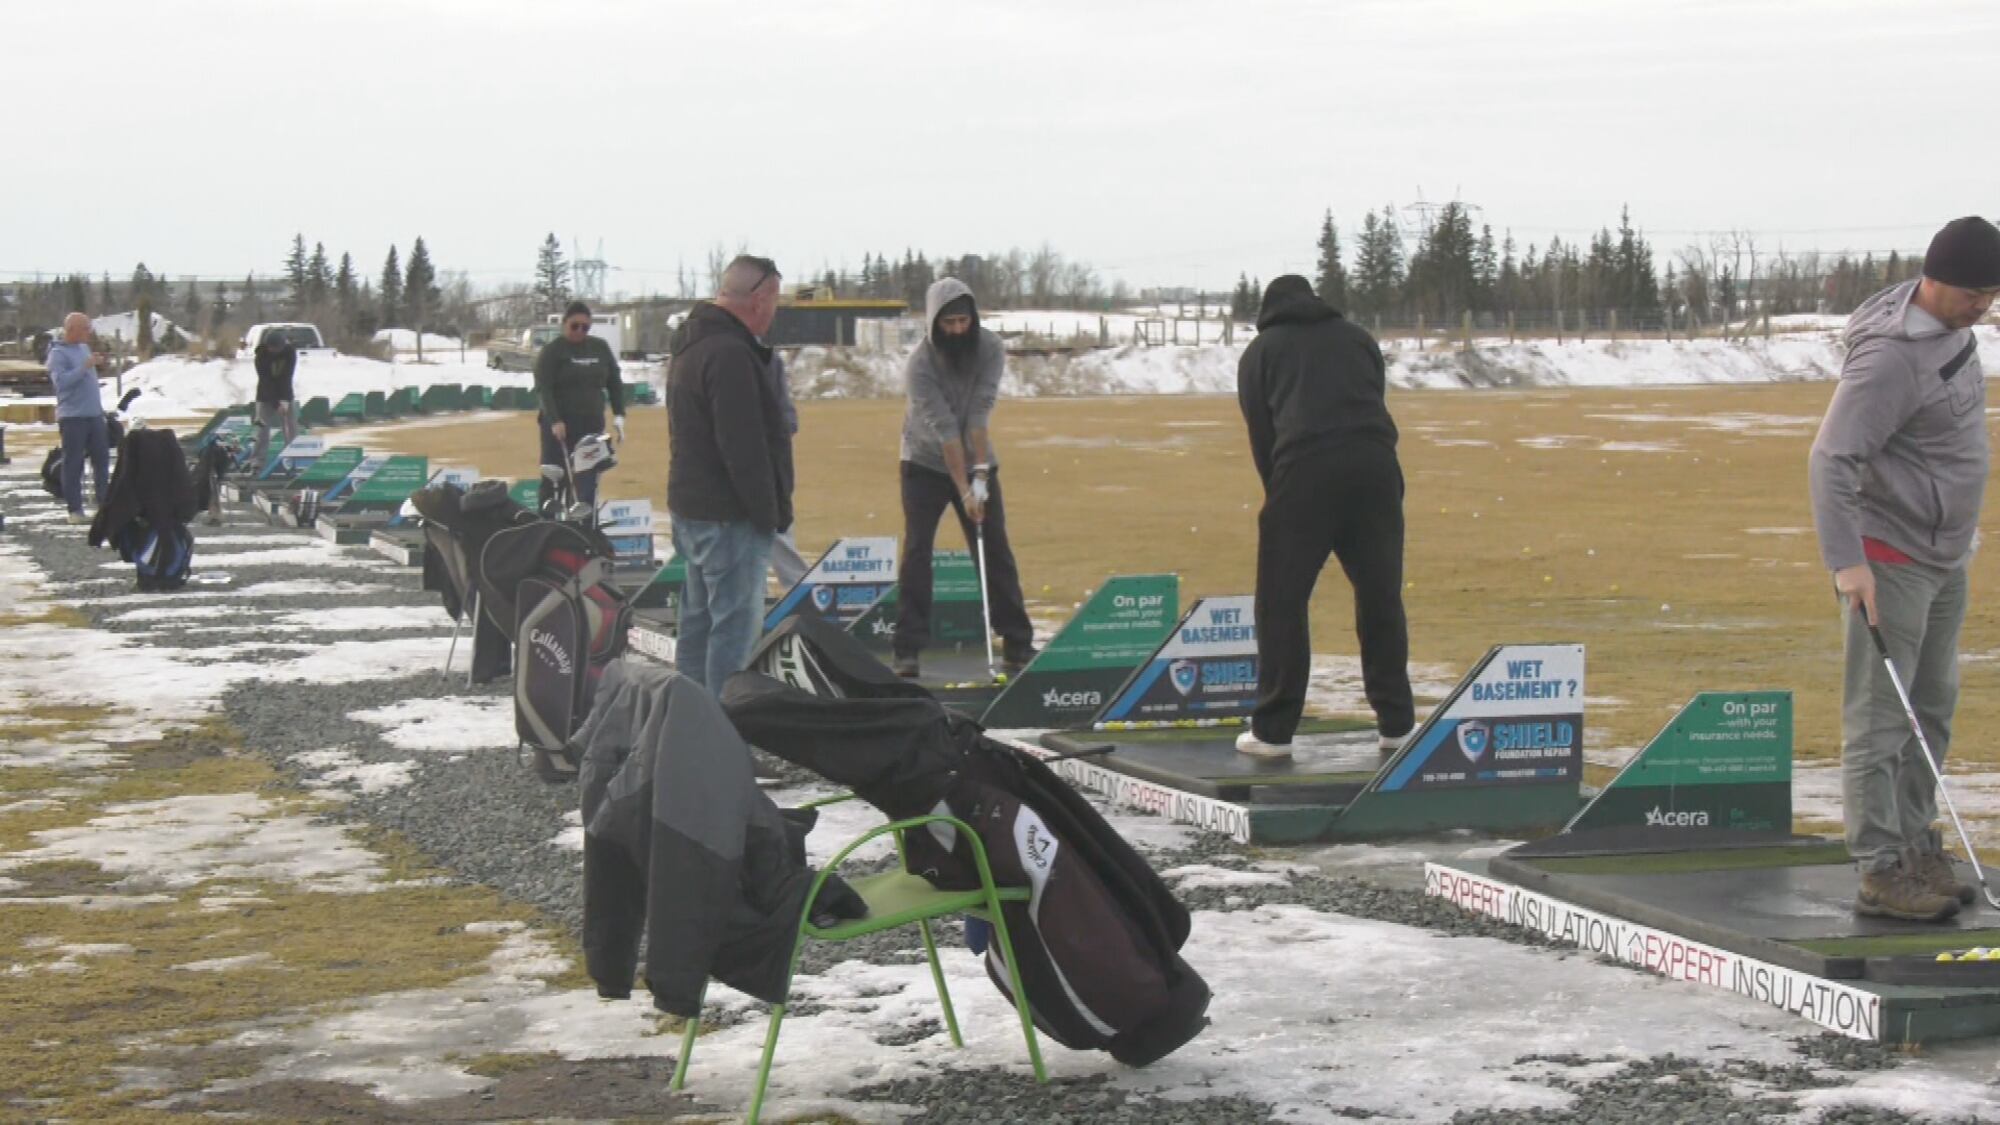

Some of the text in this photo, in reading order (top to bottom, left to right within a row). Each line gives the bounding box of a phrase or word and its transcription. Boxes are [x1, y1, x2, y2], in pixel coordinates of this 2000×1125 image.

[846, 547, 869, 558] WET
[822, 560, 882, 572] BASEMENT
[1114, 595, 1164, 610] On par
[1210, 608, 1241, 624] WET
[1507, 660, 1543, 680] WET
[1044, 688, 1101, 707] Acera
[1472, 679, 1578, 701] BASEMENT ?
[1723, 702, 1778, 717] On par
[1753, 718, 1778, 729] your
[1493, 721, 1573, 749] SHIELD
[1689, 731, 1740, 741] insurance
[1495, 747, 1571, 760] FOUNDATION REPAIR
[1131, 782, 1172, 819] EXPERT
[1176, 793, 1250, 840] INSULATION
[1645, 805, 1709, 827] Acera
[1439, 872, 1874, 1038] EXPERT INSULATION EXPERT INSULATION
